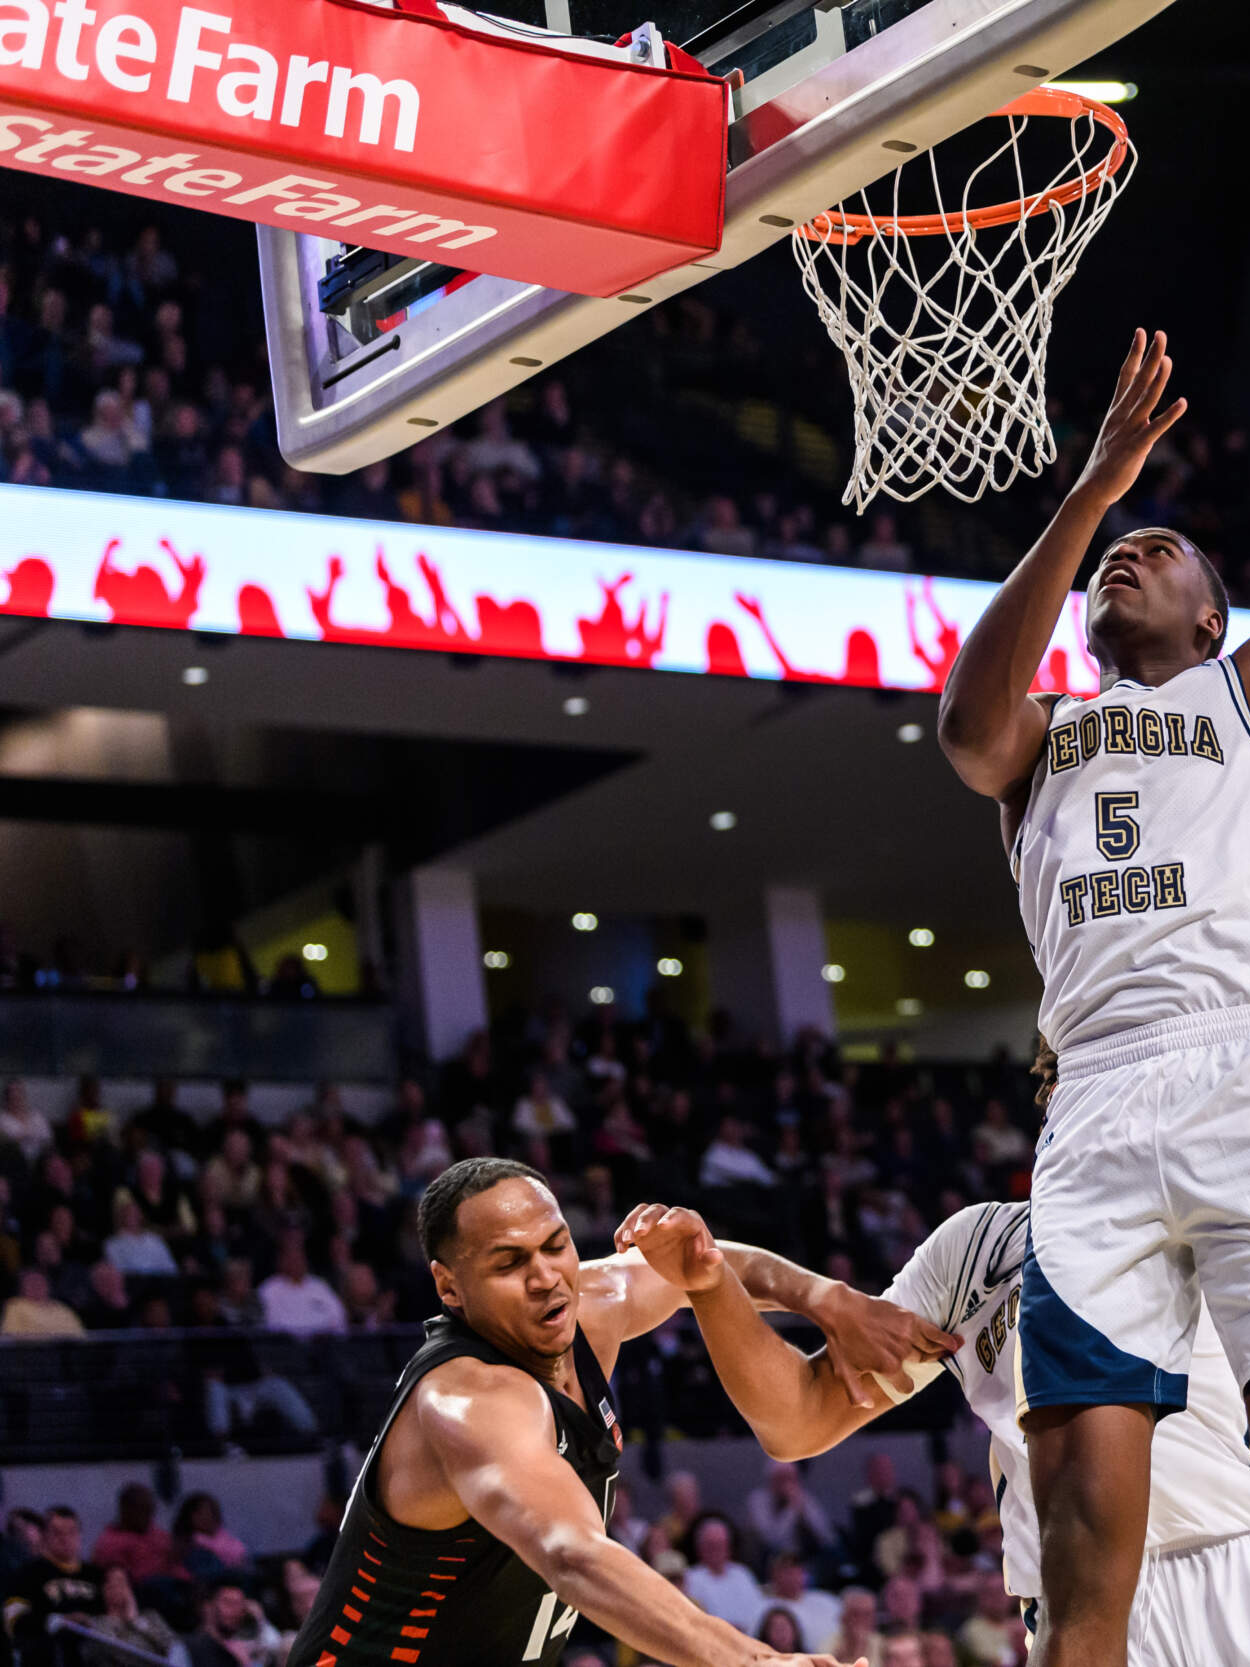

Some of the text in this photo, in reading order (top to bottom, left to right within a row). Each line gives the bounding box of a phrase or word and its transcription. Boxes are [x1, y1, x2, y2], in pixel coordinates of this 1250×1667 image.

[166, 6, 421, 153] Farm
[0, 115, 498, 250] State Farm
[1095, 791, 1140, 862] 5
[1060, 862, 1187, 928] TECH
